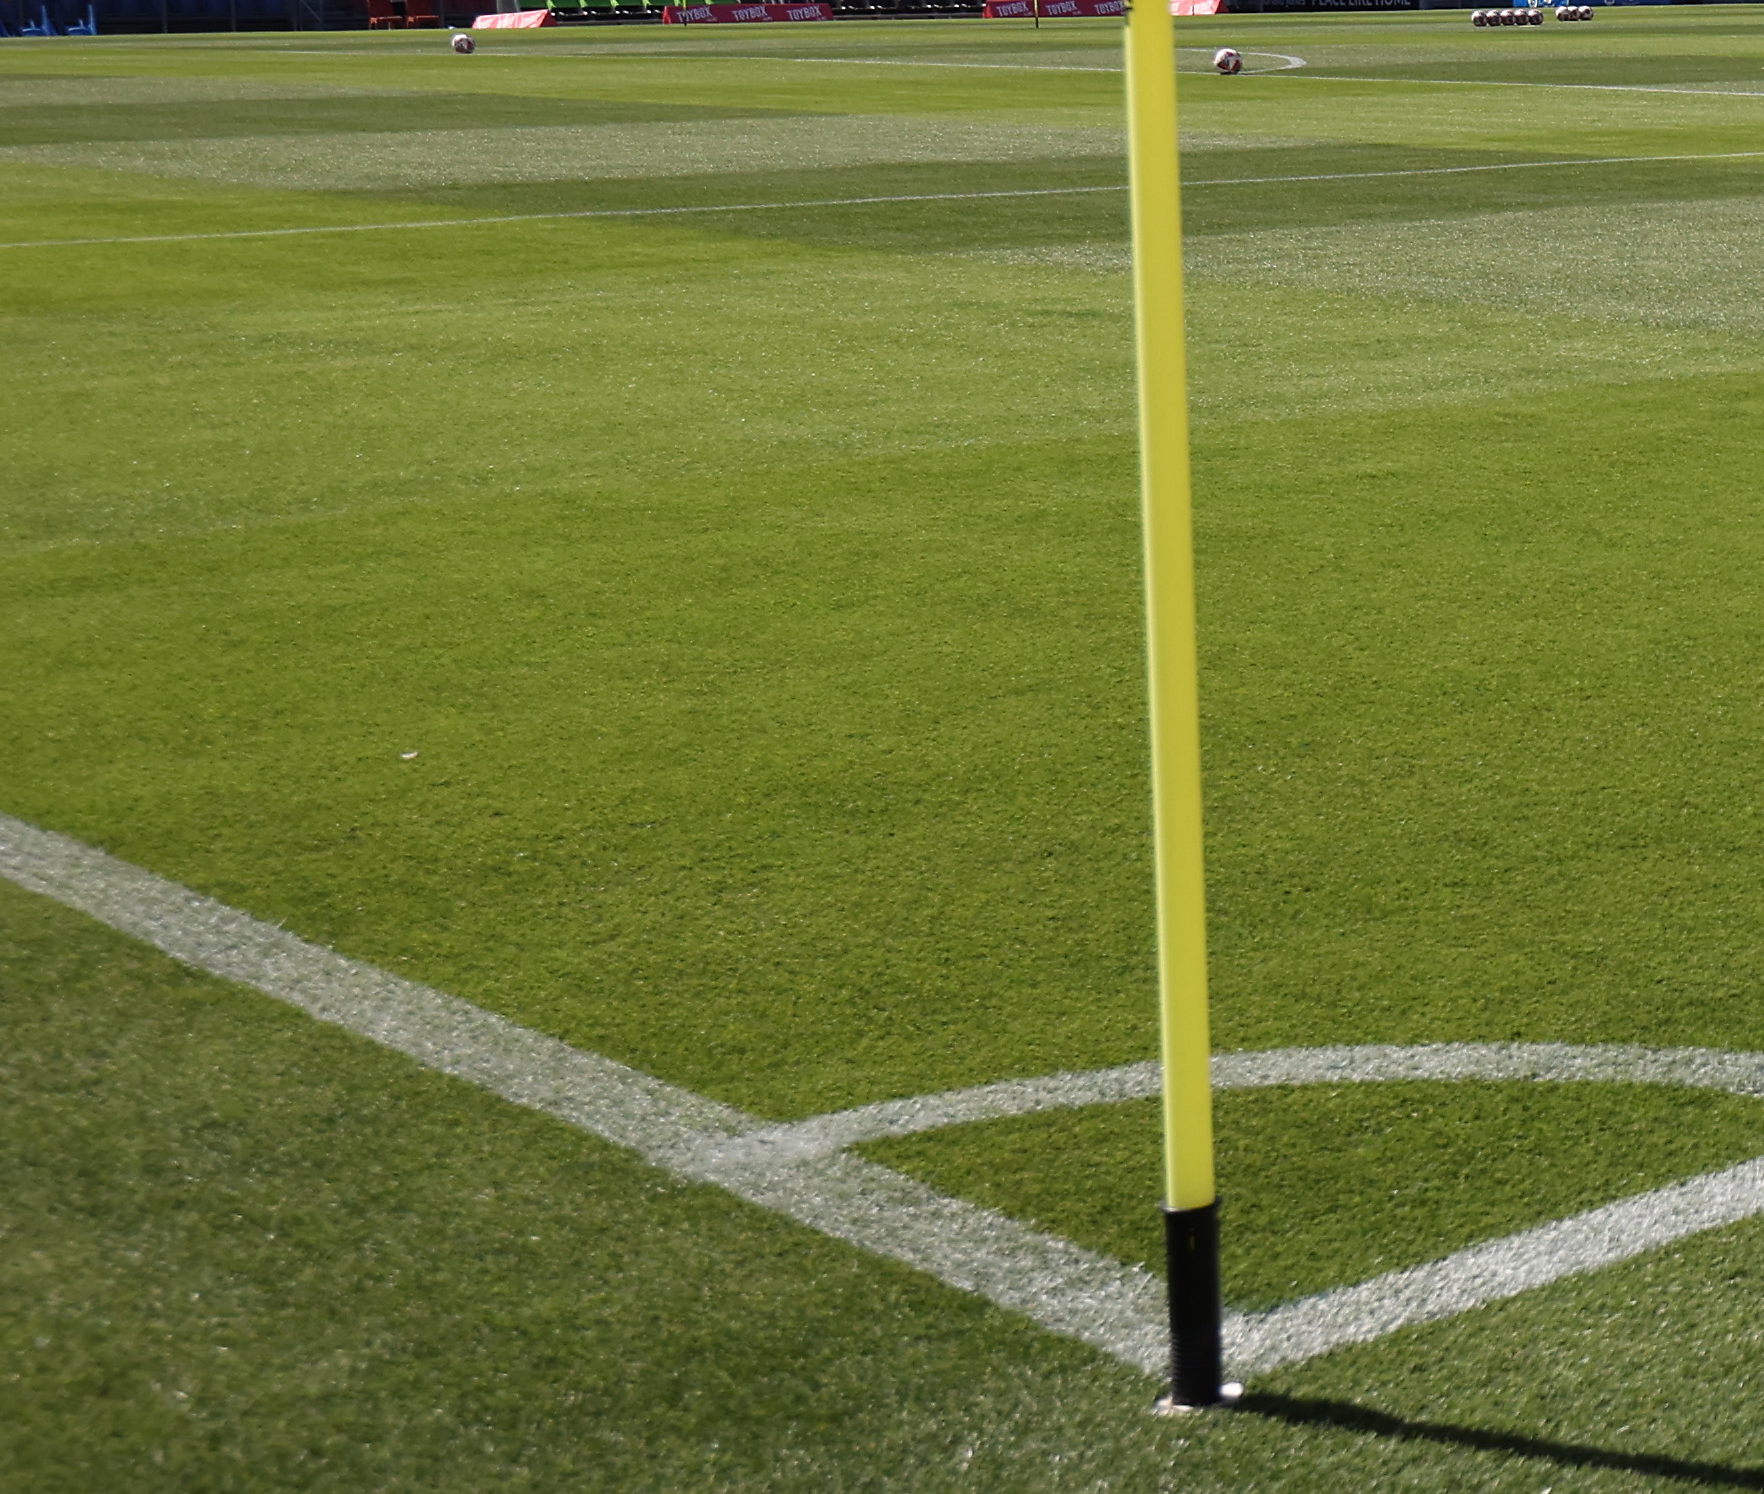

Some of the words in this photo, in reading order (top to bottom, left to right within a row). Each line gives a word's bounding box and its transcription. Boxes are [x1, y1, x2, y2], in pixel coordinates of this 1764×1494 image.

[676, 5, 713, 23] TOYBOX
[732, 5, 769, 22] TOYBOX
[787, 5, 822, 22] TOYBOX
[996, 1, 1029, 17] TOYBOX
[1046, 0, 1078, 16] TOYBOX
[1094, 0, 1125, 15] TOYBOX
